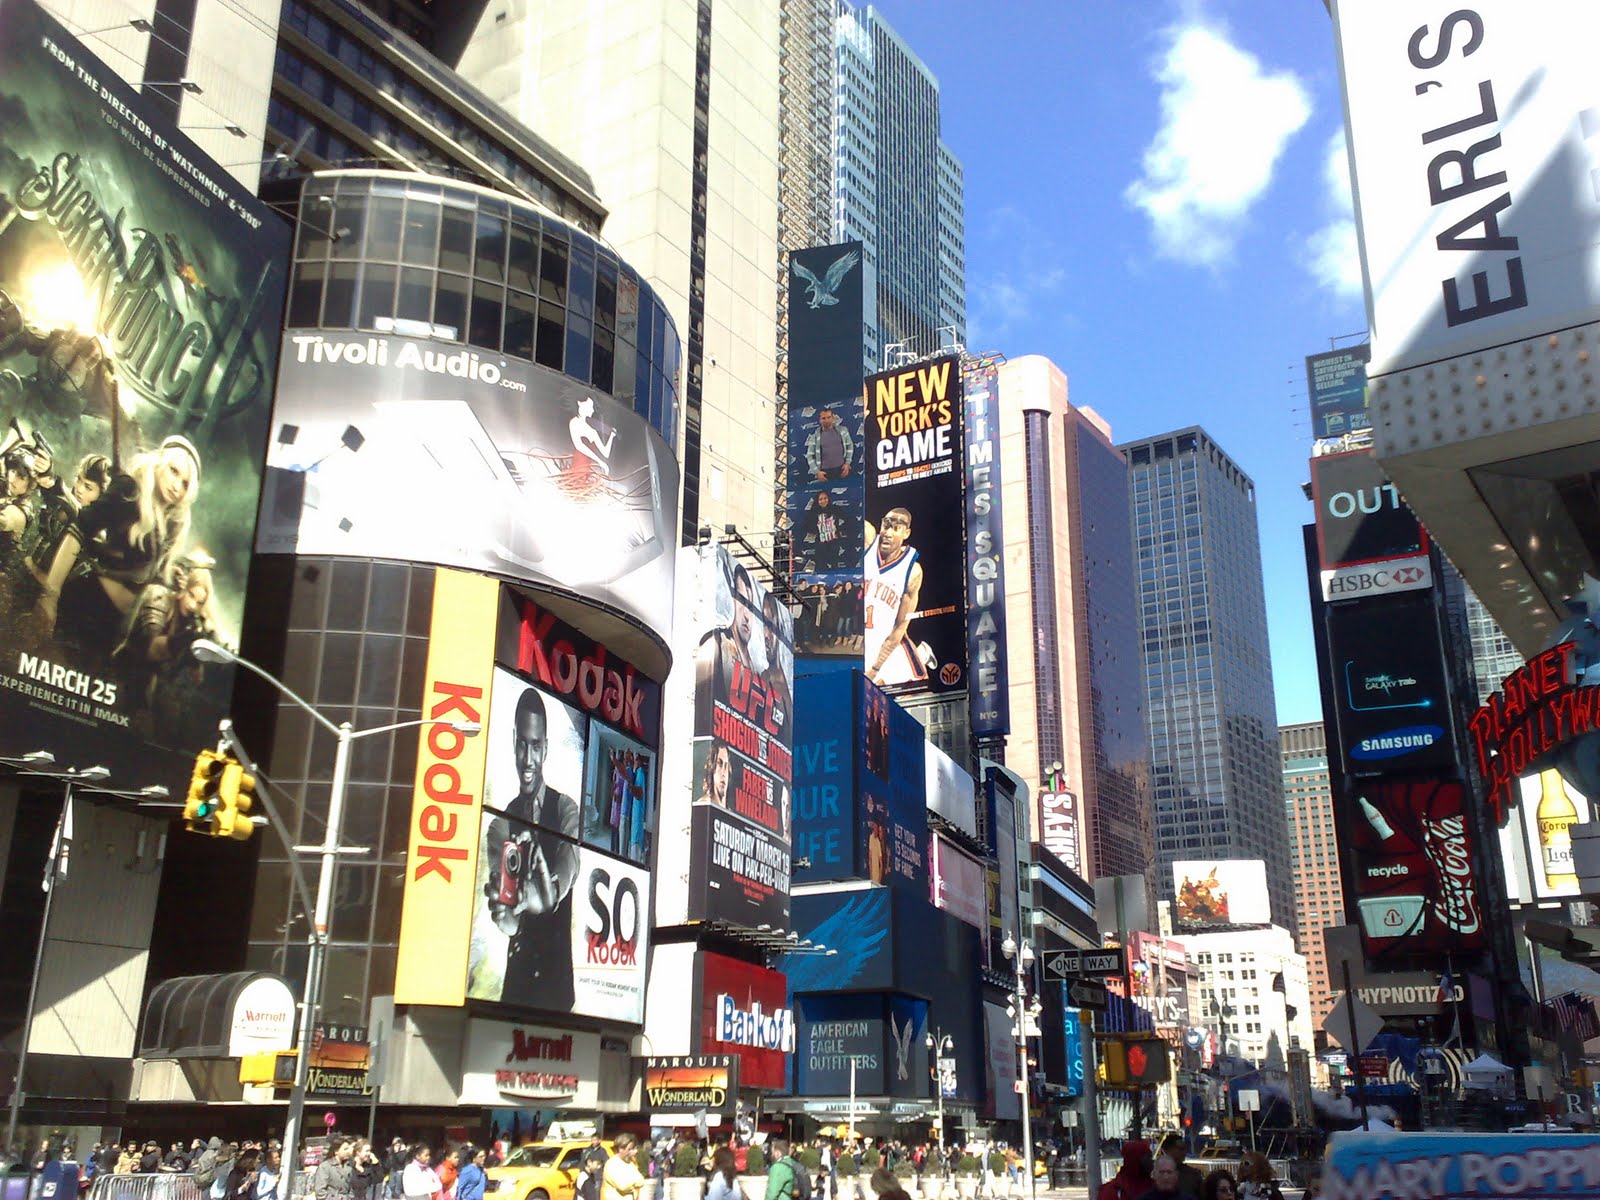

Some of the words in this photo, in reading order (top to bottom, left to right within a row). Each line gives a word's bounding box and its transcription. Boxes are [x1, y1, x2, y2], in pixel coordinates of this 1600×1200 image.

[42, 37, 76, 72] FROM
[77, 67, 99, 92] THE
[100, 86, 153, 138] DIRECTOR
[153, 132, 168, 151] OF
[101, 109, 120, 130] YOU
[121, 124, 142, 151] WILL
[143, 142, 155, 162] BE
[156, 153, 211, 208] UNPREPARED
[1407, 9, 1528, 328] EARL'S
[292, 336, 388, 367] Tivoli
[876, 362, 951, 416] NEW
[877, 400, 952, 439] YORK'S
[876, 424, 953, 471] GAME
[965, 391, 993, 516] TIMES
[1329, 485, 1400, 518] OUT
[1328, 571, 1390, 594] HSBC
[972, 531, 998, 692] SQUARE
[18, 652, 91, 697] MARCH
[91, 679, 118, 706] 25
[517, 600, 647, 738] Kodak
[0, 674, 64, 706] EXPERIENCE
[67, 697, 78, 710] IT
[80, 701, 91, 715] IN
[95, 707, 129, 727] IMAX
[729, 657, 783, 736] UFC
[979, 710, 998, 721] NYC
[1469, 641, 1577, 777] PLANET
[714, 706, 759, 760] SHOGUN
[767, 740, 793, 783] JONES
[1362, 734, 1433, 751] SAMSUNG
[414, 681, 483, 884] Kodak
[743, 767, 767, 801] FABER
[736, 787, 778, 831] WINELAND
[713, 818, 755, 857] SATURDAY
[756, 838, 782, 870] MARCH
[782, 852, 790, 875] 19
[713, 842, 731, 869] LIVE
[731, 850, 744, 875] ON
[745, 857, 790, 895] PAY-PER-VIEW
[1368, 864, 1408, 877] recycle
[584, 868, 640, 947] SO
[587, 933, 637, 966] Kodak
[1055, 959, 1079, 971] ONE
[1088, 957, 1113, 969] WAY
[241, 1010, 287, 1022] Marriott
[1358, 985, 1464, 1004] HYPNOTIZD
[716, 994, 764, 1047] Bank
[811, 1022, 868, 1039] AMERICAN
[647, 1056, 730, 1068] MARQUIS
[809, 1054, 878, 1070] OUTFITTERS
[810, 1040, 844, 1054] EAGLE
[649, 1088, 726, 1108] WONDERLAND
[1325, 1155, 1453, 1200] MARY
